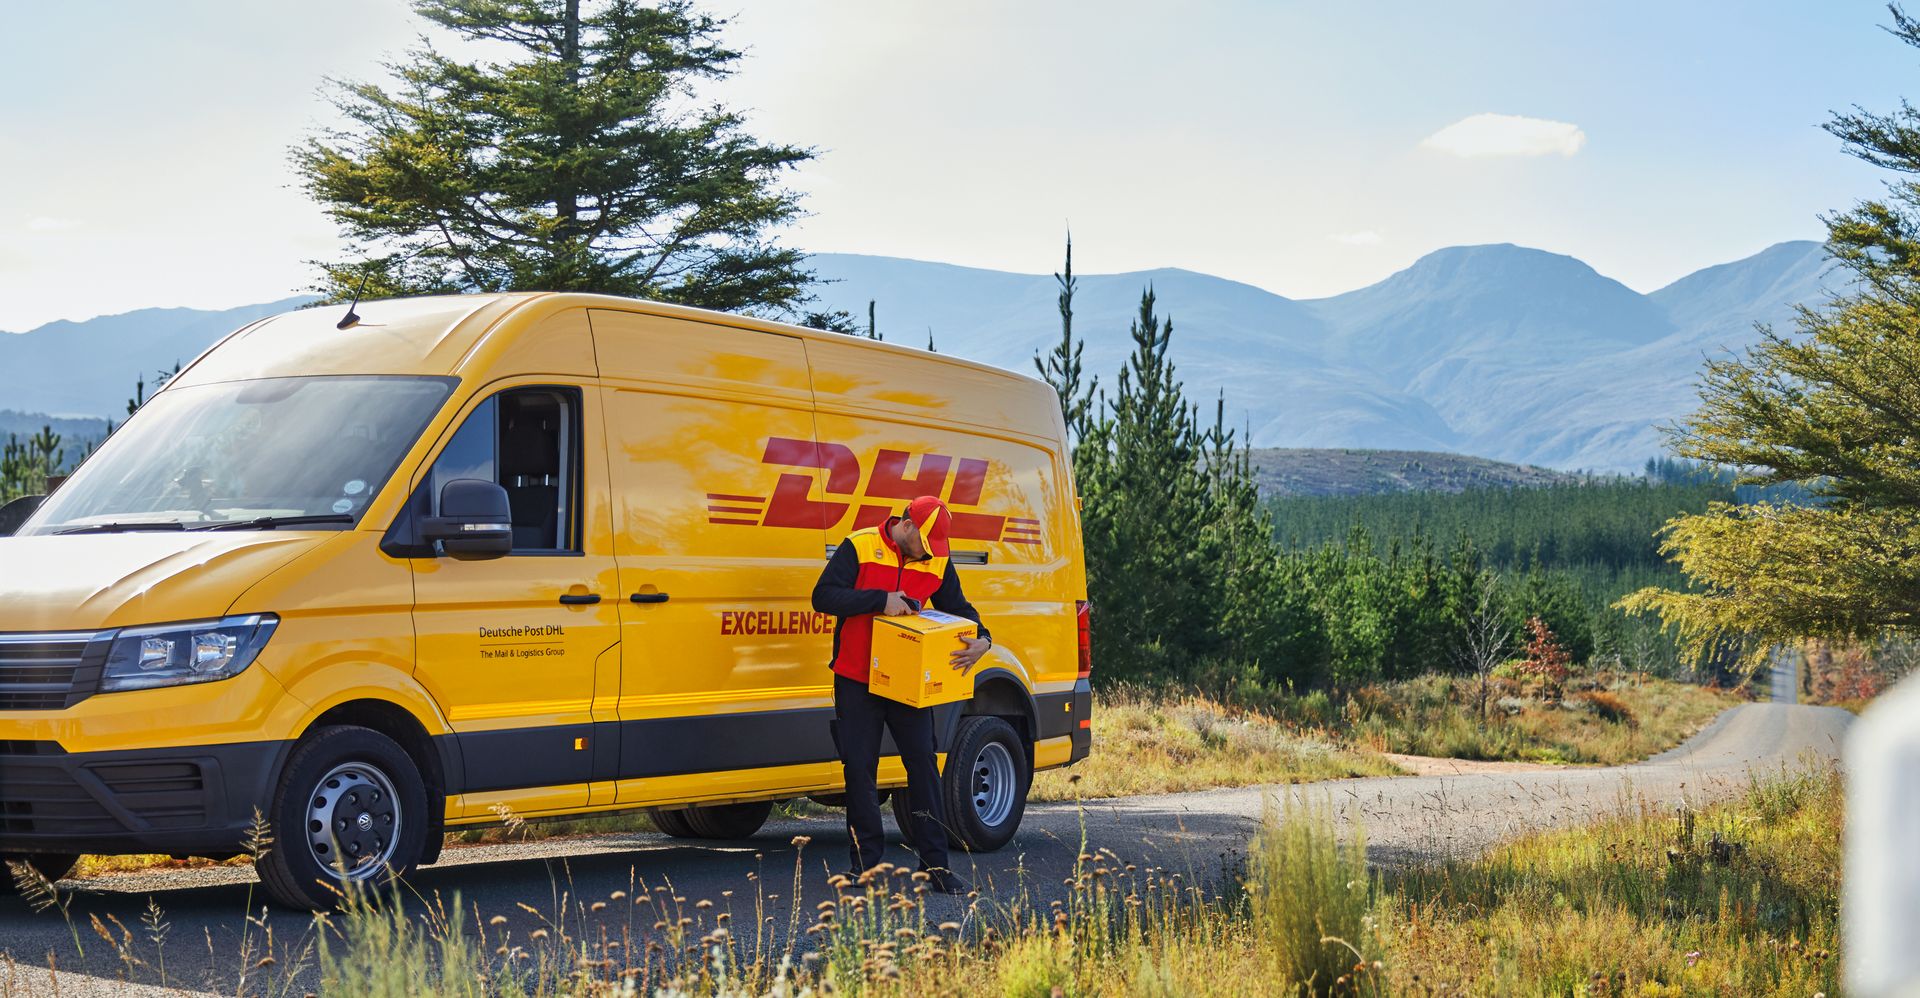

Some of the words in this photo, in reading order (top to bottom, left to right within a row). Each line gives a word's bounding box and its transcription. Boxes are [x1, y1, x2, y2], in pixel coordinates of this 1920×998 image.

[762, 437, 1006, 541] DHL
[479, 626, 523, 638] Deutsche
[524, 625, 544, 636] Post
[545, 624, 565, 636] DHL
[898, 632, 920, 643] DHL
[480, 650, 493, 658] The
[494, 649, 509, 658] Mail
[509, 649, 515, 657] &
[516, 648, 544, 659] Logistics
[545, 648, 565, 657] Group
